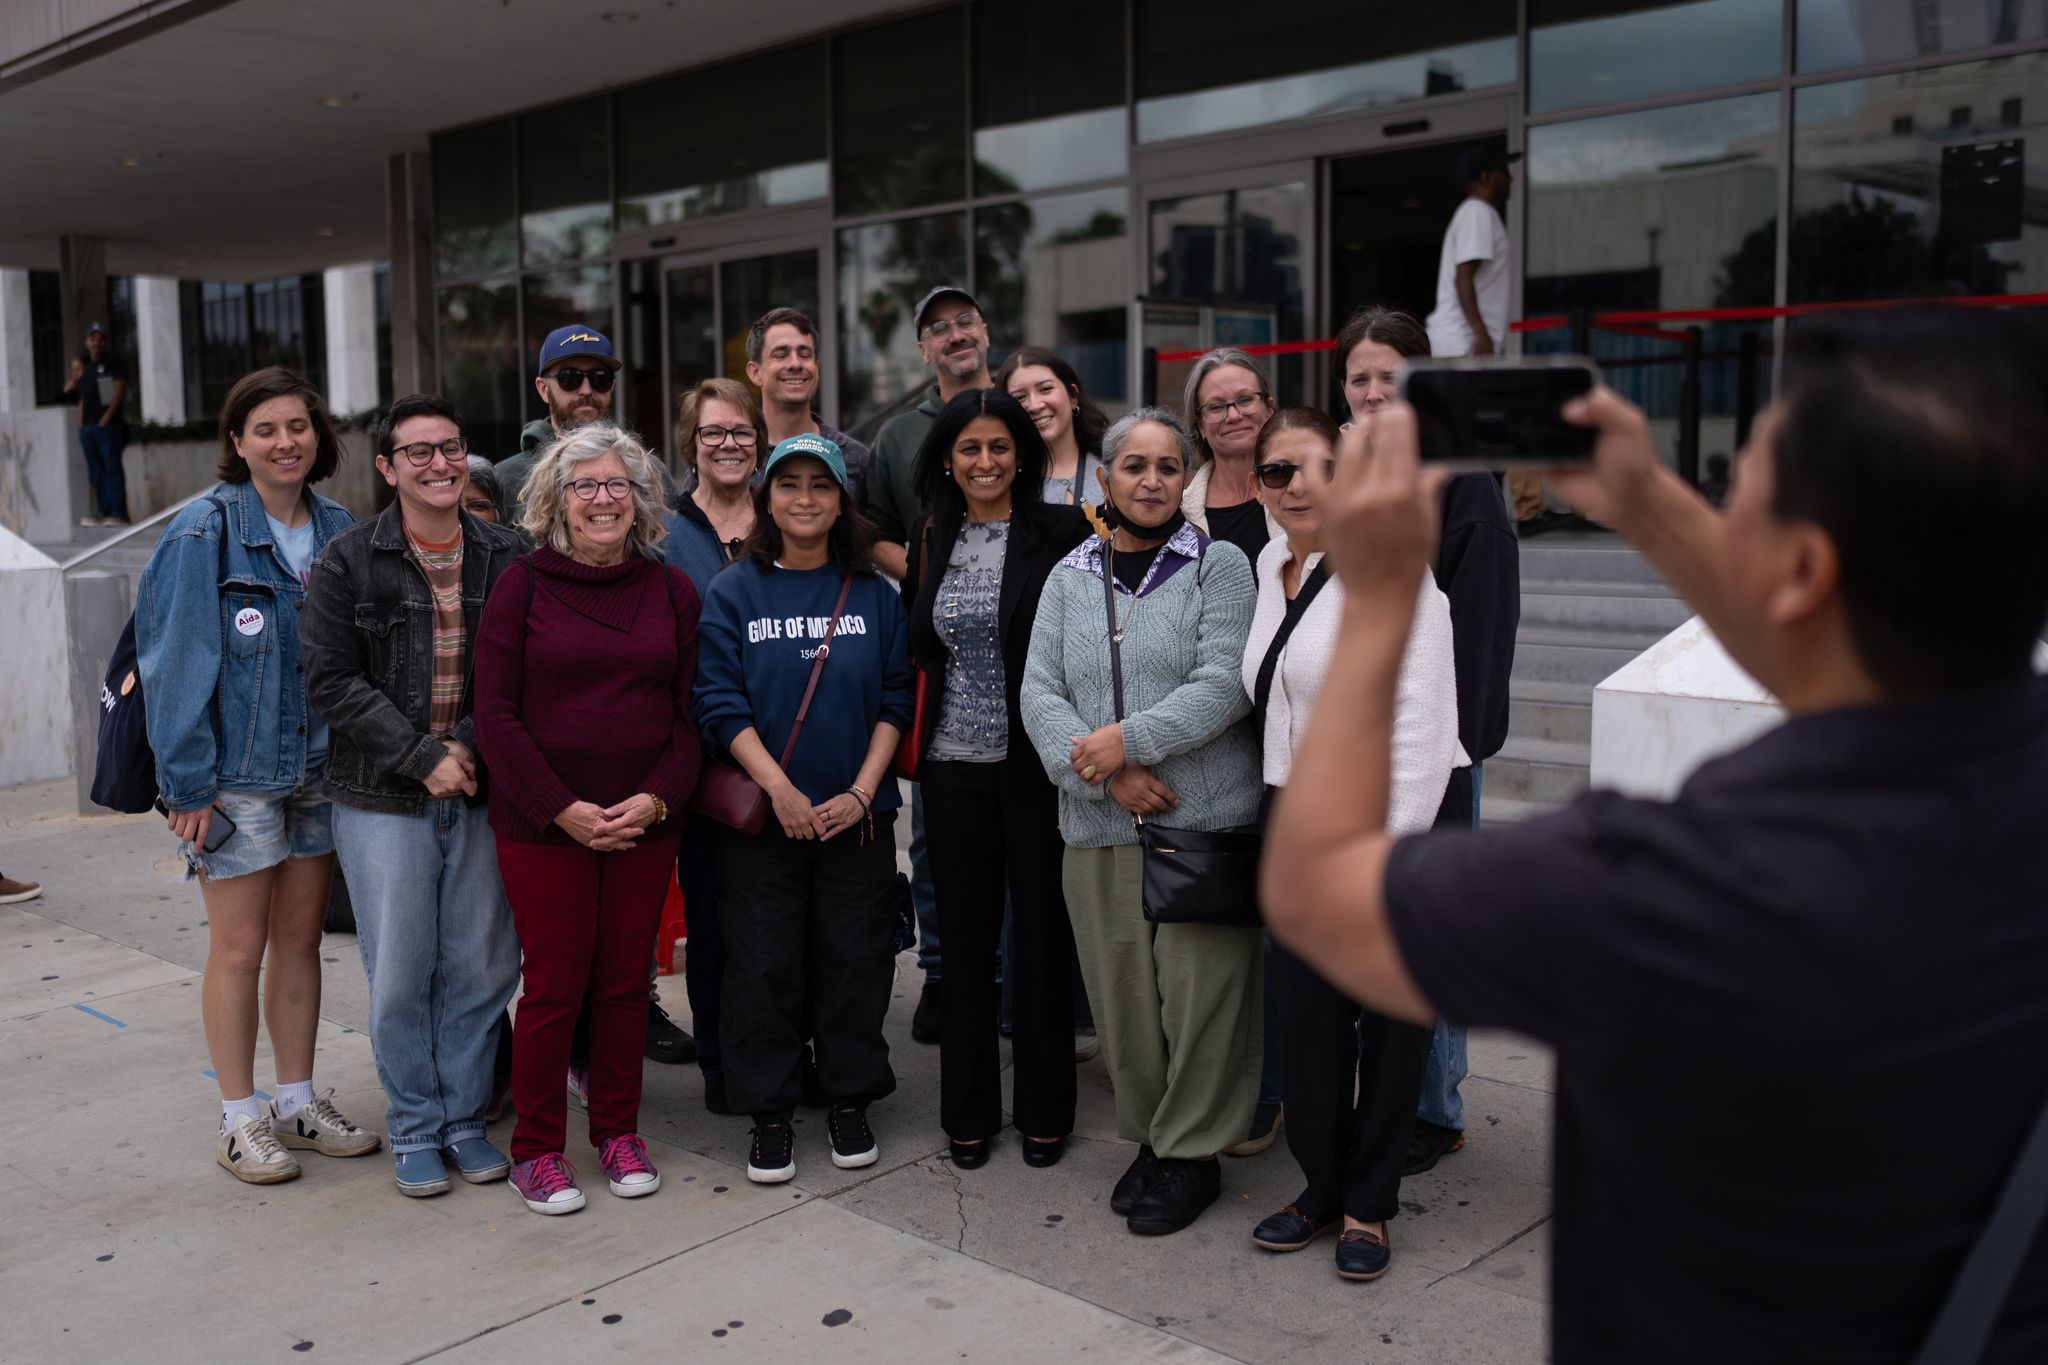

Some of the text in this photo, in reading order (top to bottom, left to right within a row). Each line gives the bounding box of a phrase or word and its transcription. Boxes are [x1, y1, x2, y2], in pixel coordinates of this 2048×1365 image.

[748, 614, 866, 643] GULF OF MEXICO
